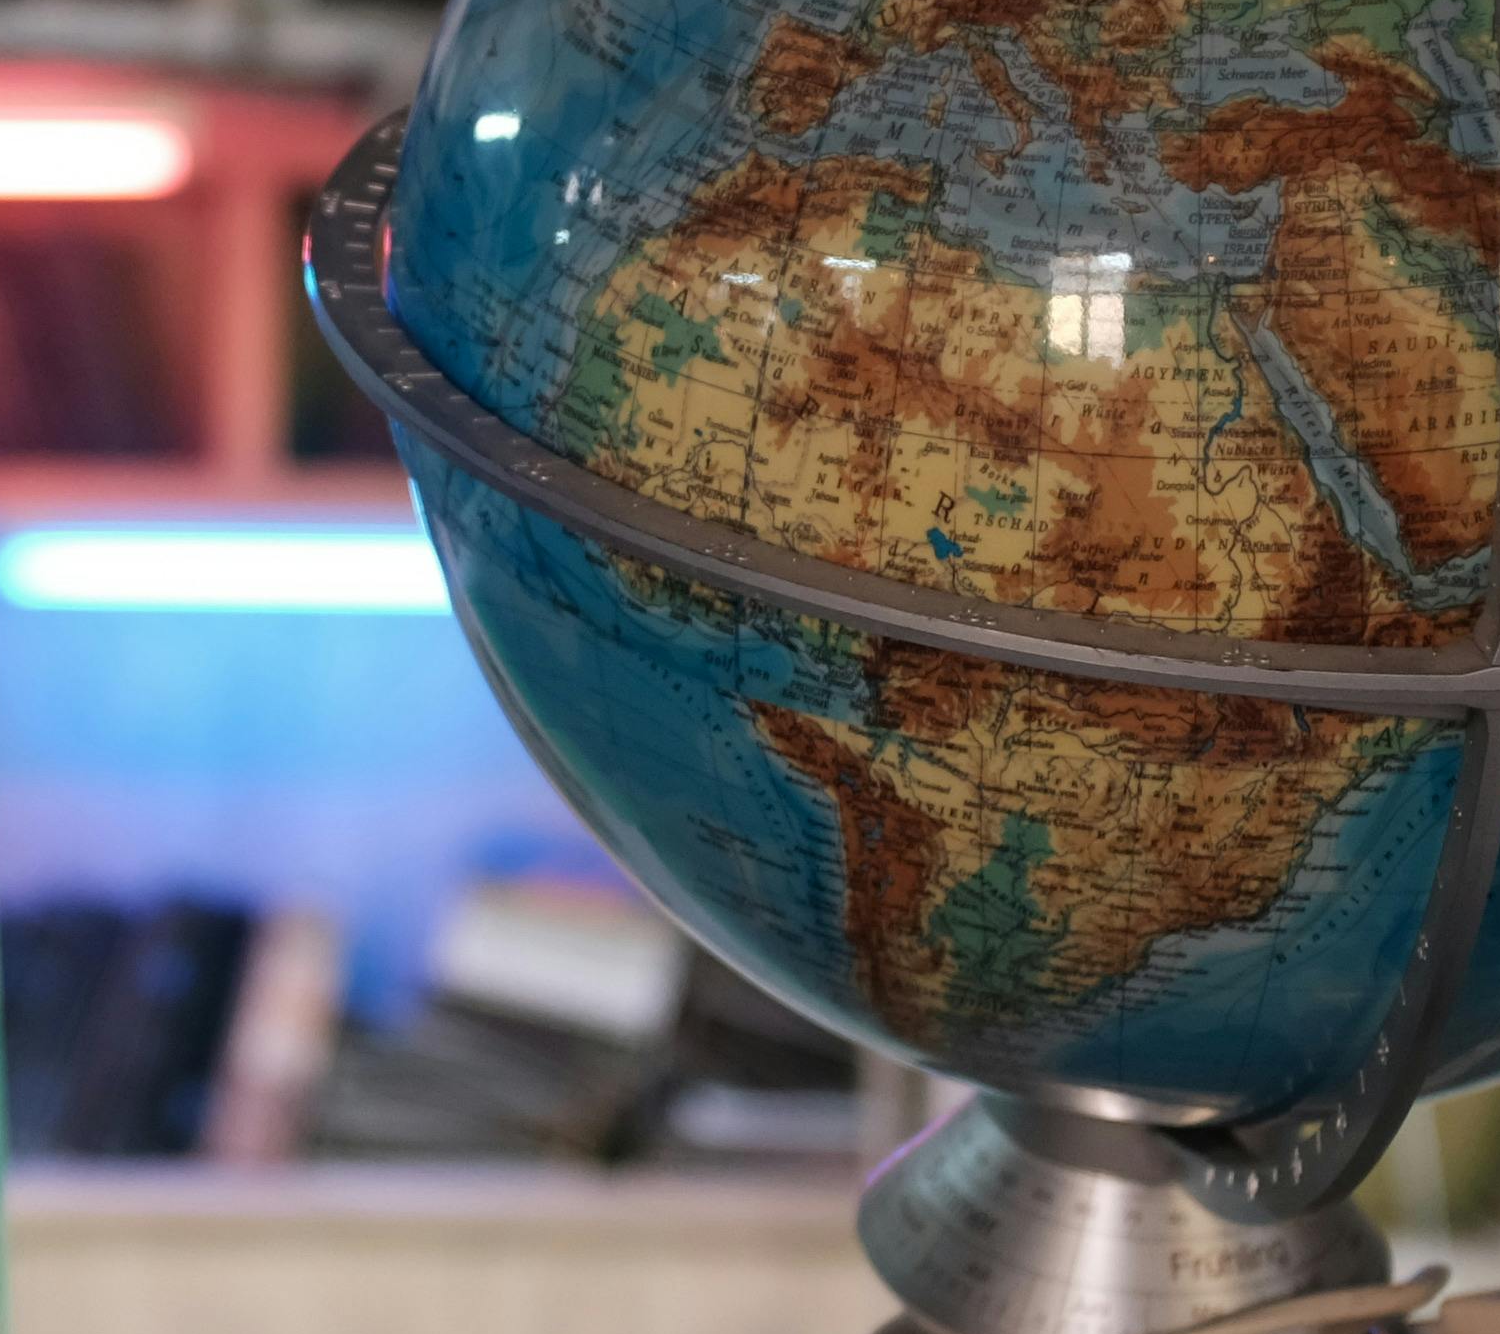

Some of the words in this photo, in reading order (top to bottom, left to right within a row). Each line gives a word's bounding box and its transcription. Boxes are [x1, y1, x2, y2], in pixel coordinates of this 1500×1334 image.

[1279, 67, 1309, 80] Meer
[991, 185, 1036, 200] MALTA
[1294, 200, 1346, 214] SYRIEN
[1367, 333, 1455, 355] SAUDI-
[1214, 443, 1276, 457] Nubische
[816, 472, 902, 502] NIGER
[1156, 479, 1196, 493] Dongola
[973, 512, 1049, 533] TSCHAD
[1131, 536, 1230, 550] SUDAN
